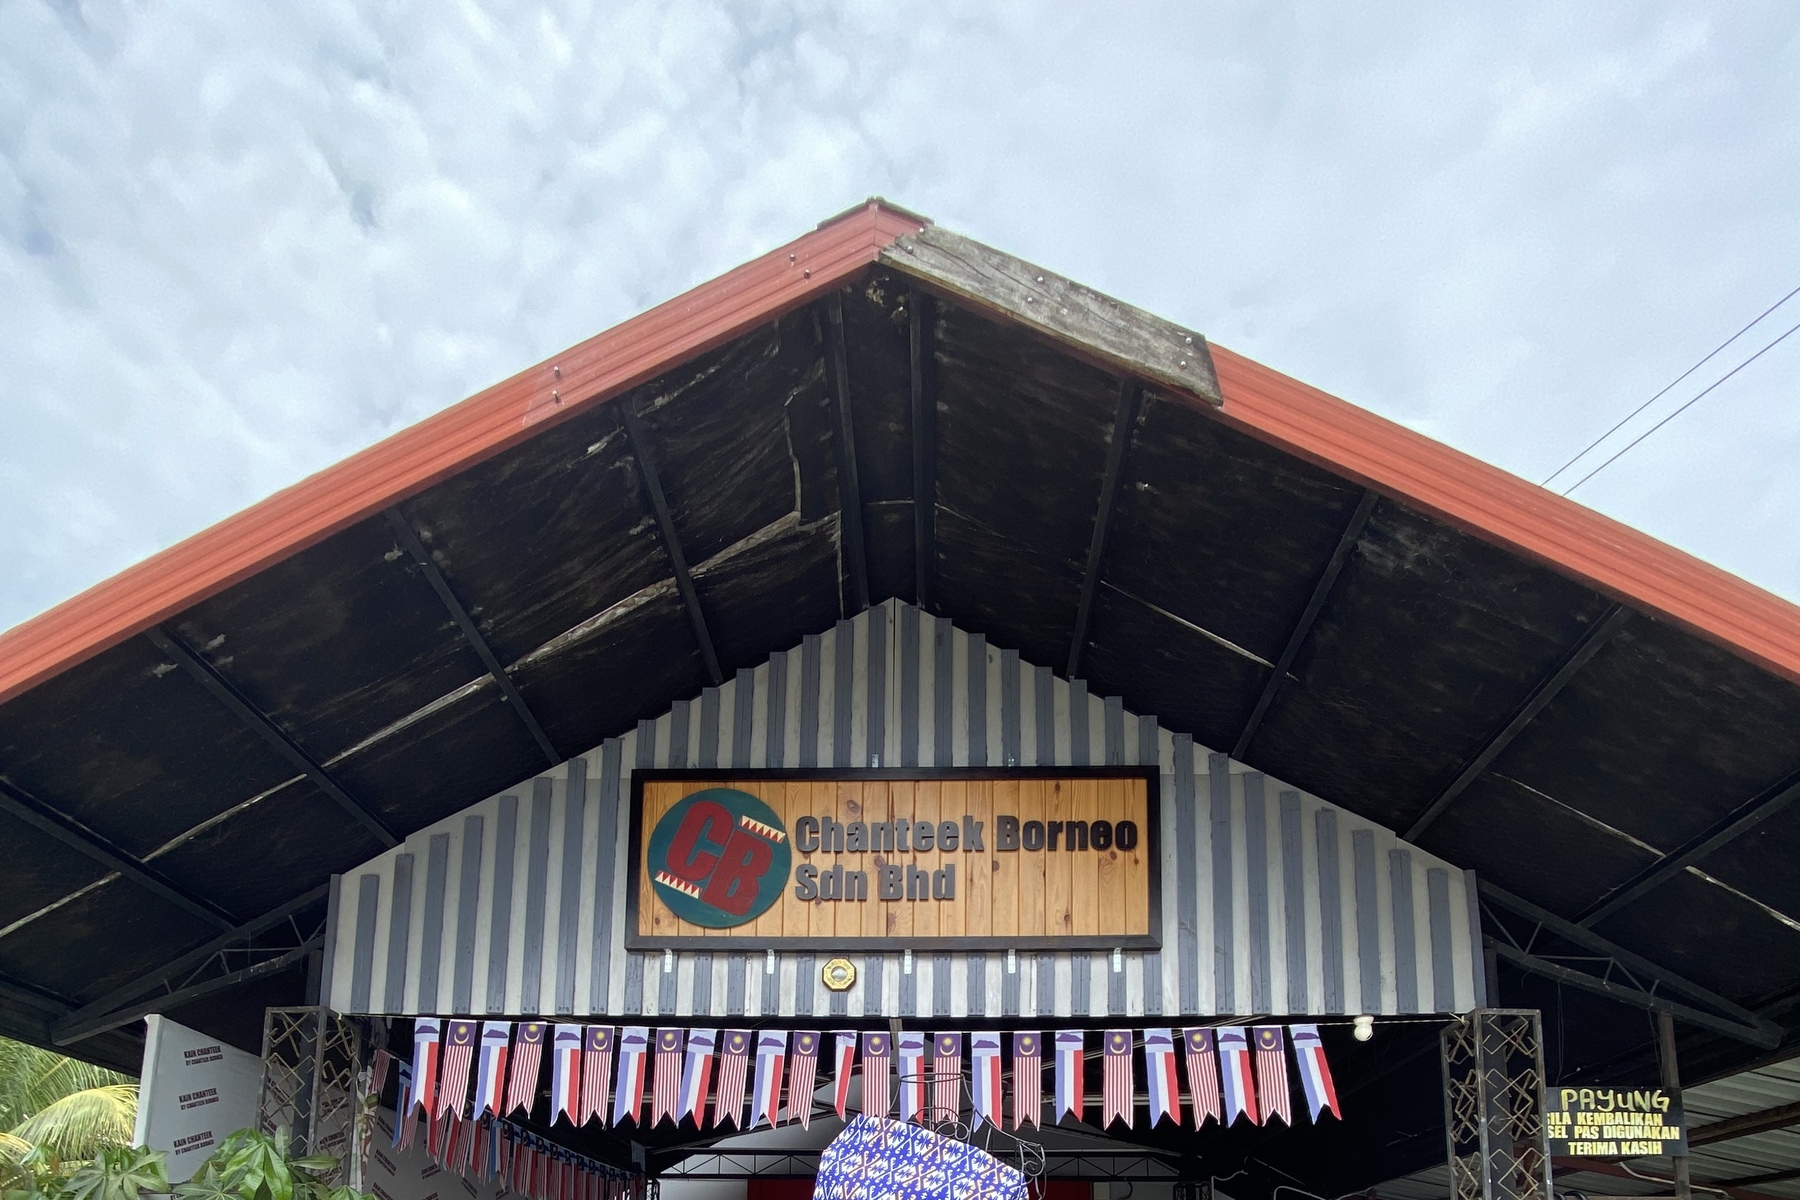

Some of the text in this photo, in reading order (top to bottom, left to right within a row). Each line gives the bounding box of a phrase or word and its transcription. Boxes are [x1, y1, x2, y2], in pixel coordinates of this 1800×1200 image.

[795, 815, 1137, 852] Chanteek Borneo
[667, 800, 773, 916] CB
[795, 863, 955, 901] Sdn Bhd
[184, 1050, 196, 1058] KAIN
[179, 1088, 217, 1103] KAIN CHANTEEK
[1561, 1089, 1669, 1113] PAYUNG
[1577, 1112, 1663, 1126] KEMBALIKAN
[173, 1131, 213, 1148] KAIN CHANTEEK
[1574, 1126, 1599, 1139] PAS
[1603, 1126, 1680, 1139] DIGUNAKAN
[1568, 1142, 1662, 1155] TERIMA KASIH
